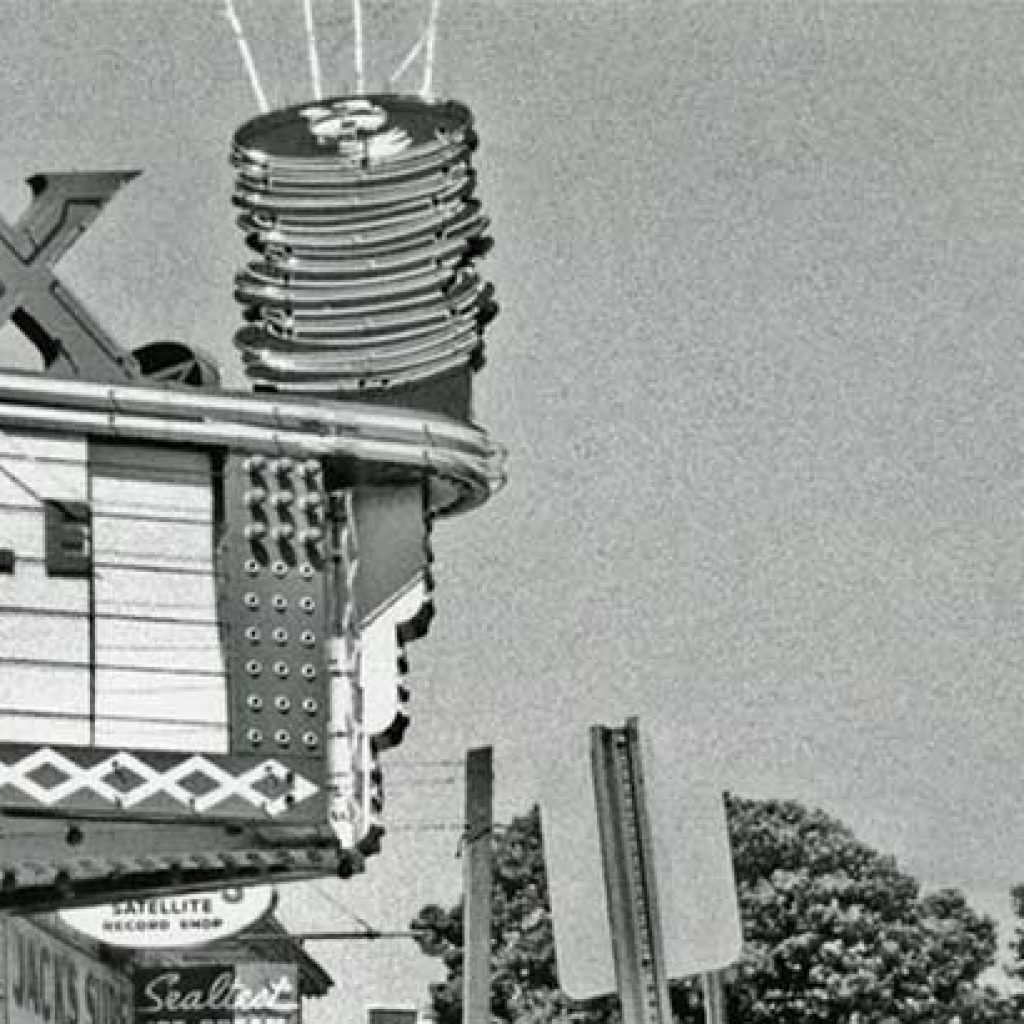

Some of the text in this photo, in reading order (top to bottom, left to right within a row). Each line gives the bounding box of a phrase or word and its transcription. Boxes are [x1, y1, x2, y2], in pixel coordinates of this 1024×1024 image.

[112, 898, 212, 915] SATELLITE
[102, 917, 223, 931] RECORD SHOP
